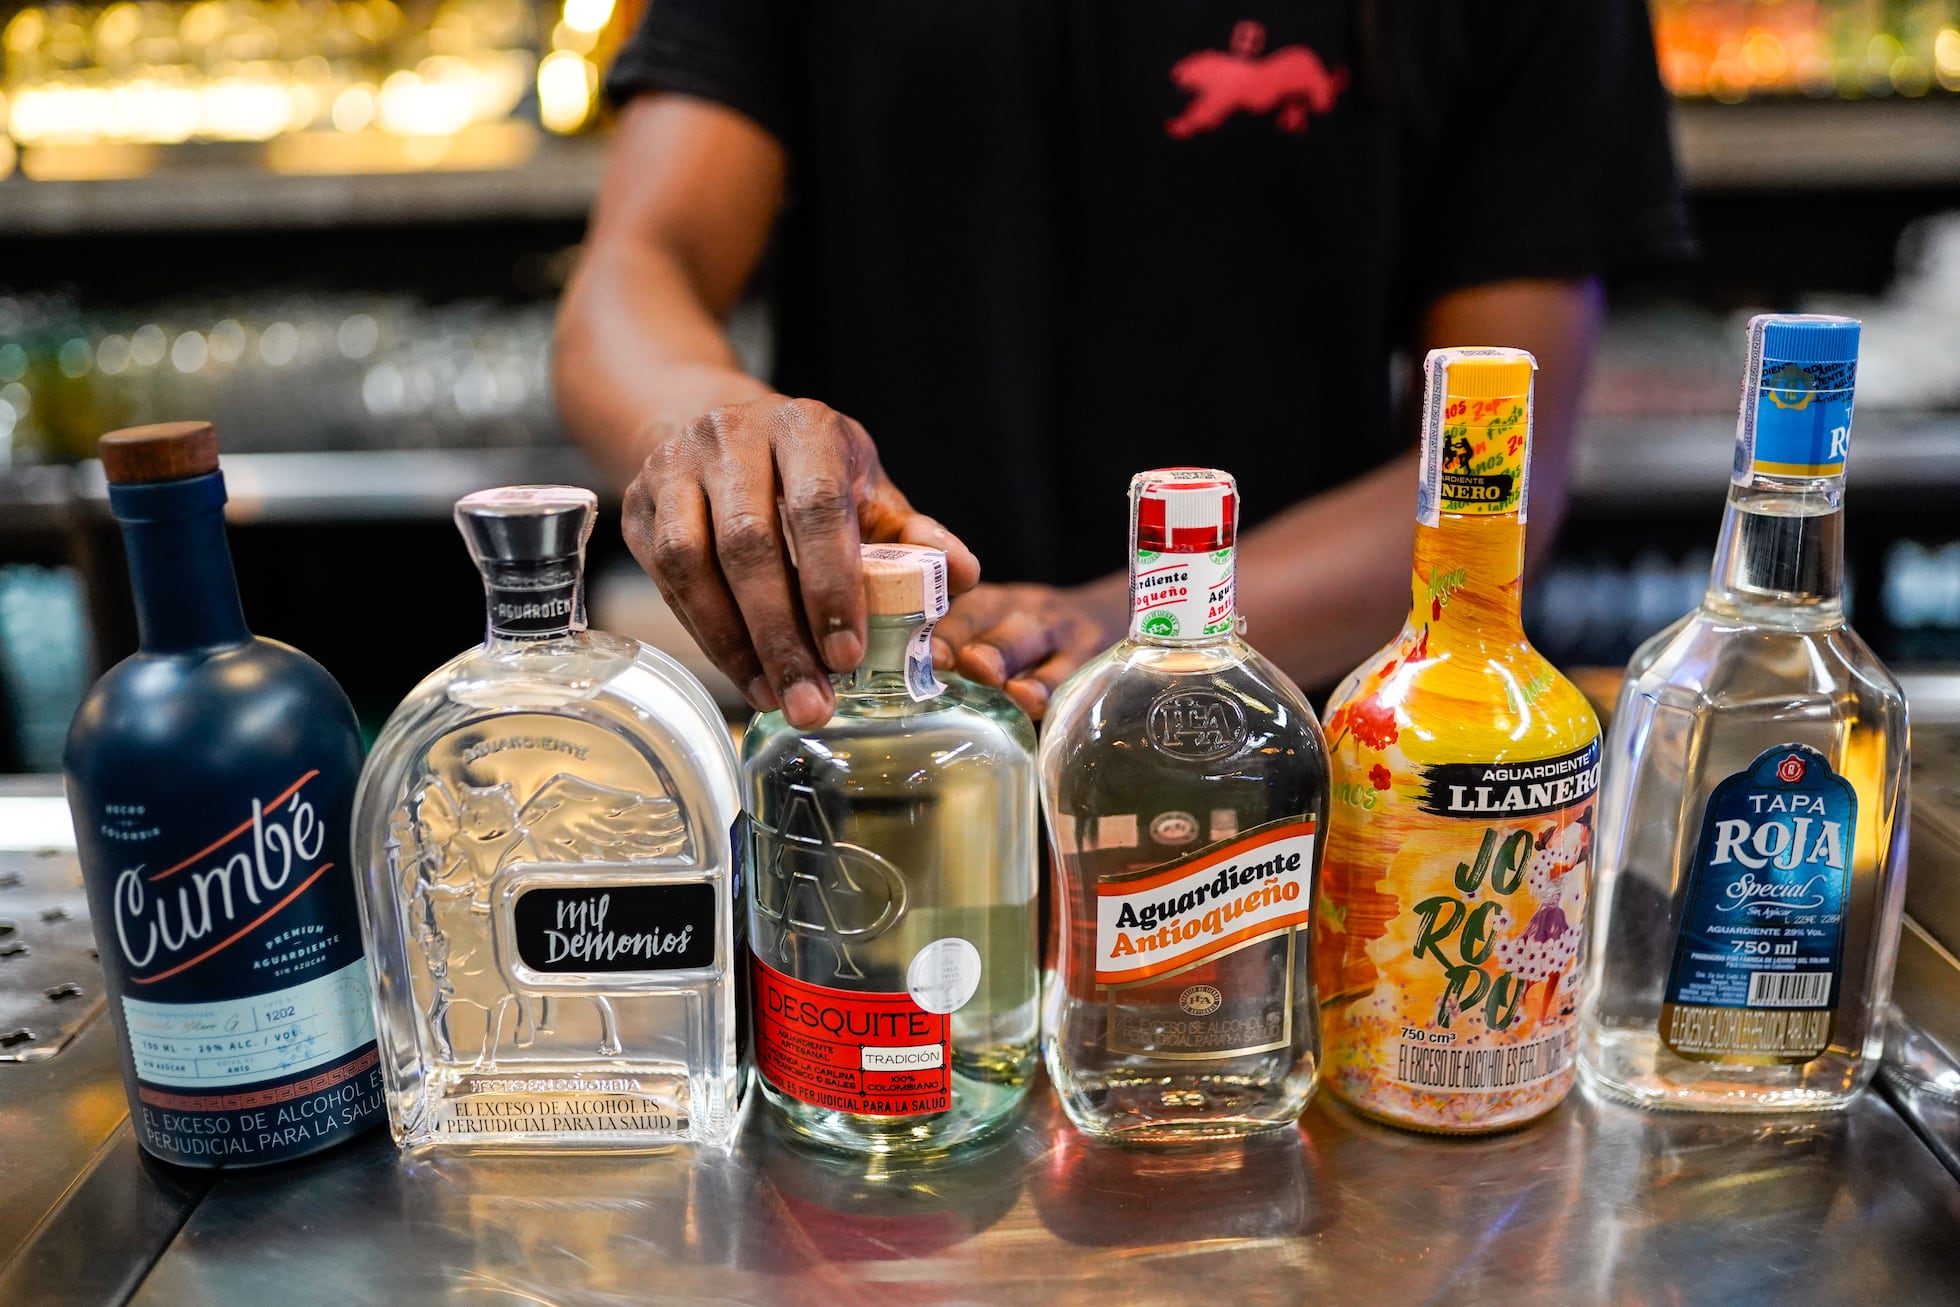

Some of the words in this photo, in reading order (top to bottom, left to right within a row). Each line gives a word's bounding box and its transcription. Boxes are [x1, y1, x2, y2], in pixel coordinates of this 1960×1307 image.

[1482, 755, 1589, 781] AGUARDIENTE
[1448, 764, 1600, 812] LLANERO
[1749, 794, 1826, 816] TAPA
[1710, 817, 1843, 870] ROJA
[114, 792, 324, 967] Cumbé
[1115, 852, 1301, 930] Aguardiente
[1717, 873, 1827, 910] Special
[1110, 877, 1301, 958] Antioqueño
[1706, 925, 1780, 937] AGUARDIENTE
[1784, 928, 1805, 936] 29%
[253, 934, 340, 969] AGUARDIENTE
[265, 925, 324, 950] PREMIUM
[543, 927, 692, 964] Demonios
[1731, 940, 1770, 954] 750
[1775, 940, 1798, 955] ml
[265, 1005, 296, 1022] 1202
[768, 986, 930, 1038] DESQUITE
[1401, 1027, 1425, 1041] 750
[865, 1050, 940, 1065] TRADICIÓN
[1410, 1046, 1447, 1087] EXCESO
[799, 1087, 859, 1111] PERJUDICIAL
[863, 1100, 891, 1112] PARA
[896, 1101, 908, 1112] LA
[911, 1096, 946, 1111] SALUD
[867, 1081, 939, 1092] COLOMBIANO
[143, 1107, 158, 1128] EL
[163, 1114, 231, 1134] EXCESO
[240, 1112, 269, 1132] DE
[277, 1081, 365, 1127] ALCOHOL
[455, 1103, 472, 1117] EL
[476, 1102, 534, 1117] EXCESO
[539, 1101, 561, 1117] DE
[564, 1100, 640, 1116] ALCOHOL
[642, 1099, 660, 1114] ES
[144, 1126, 255, 1155] PERJUDICIAL
[259, 1125, 311, 1151] PARA
[314, 1114, 338, 1137] LA
[447, 1116, 552, 1133] PERJUDICIAL
[553, 1116, 597, 1132] PARA
[599, 1116, 619, 1131] LA
[622, 1115, 671, 1130] SALUD
